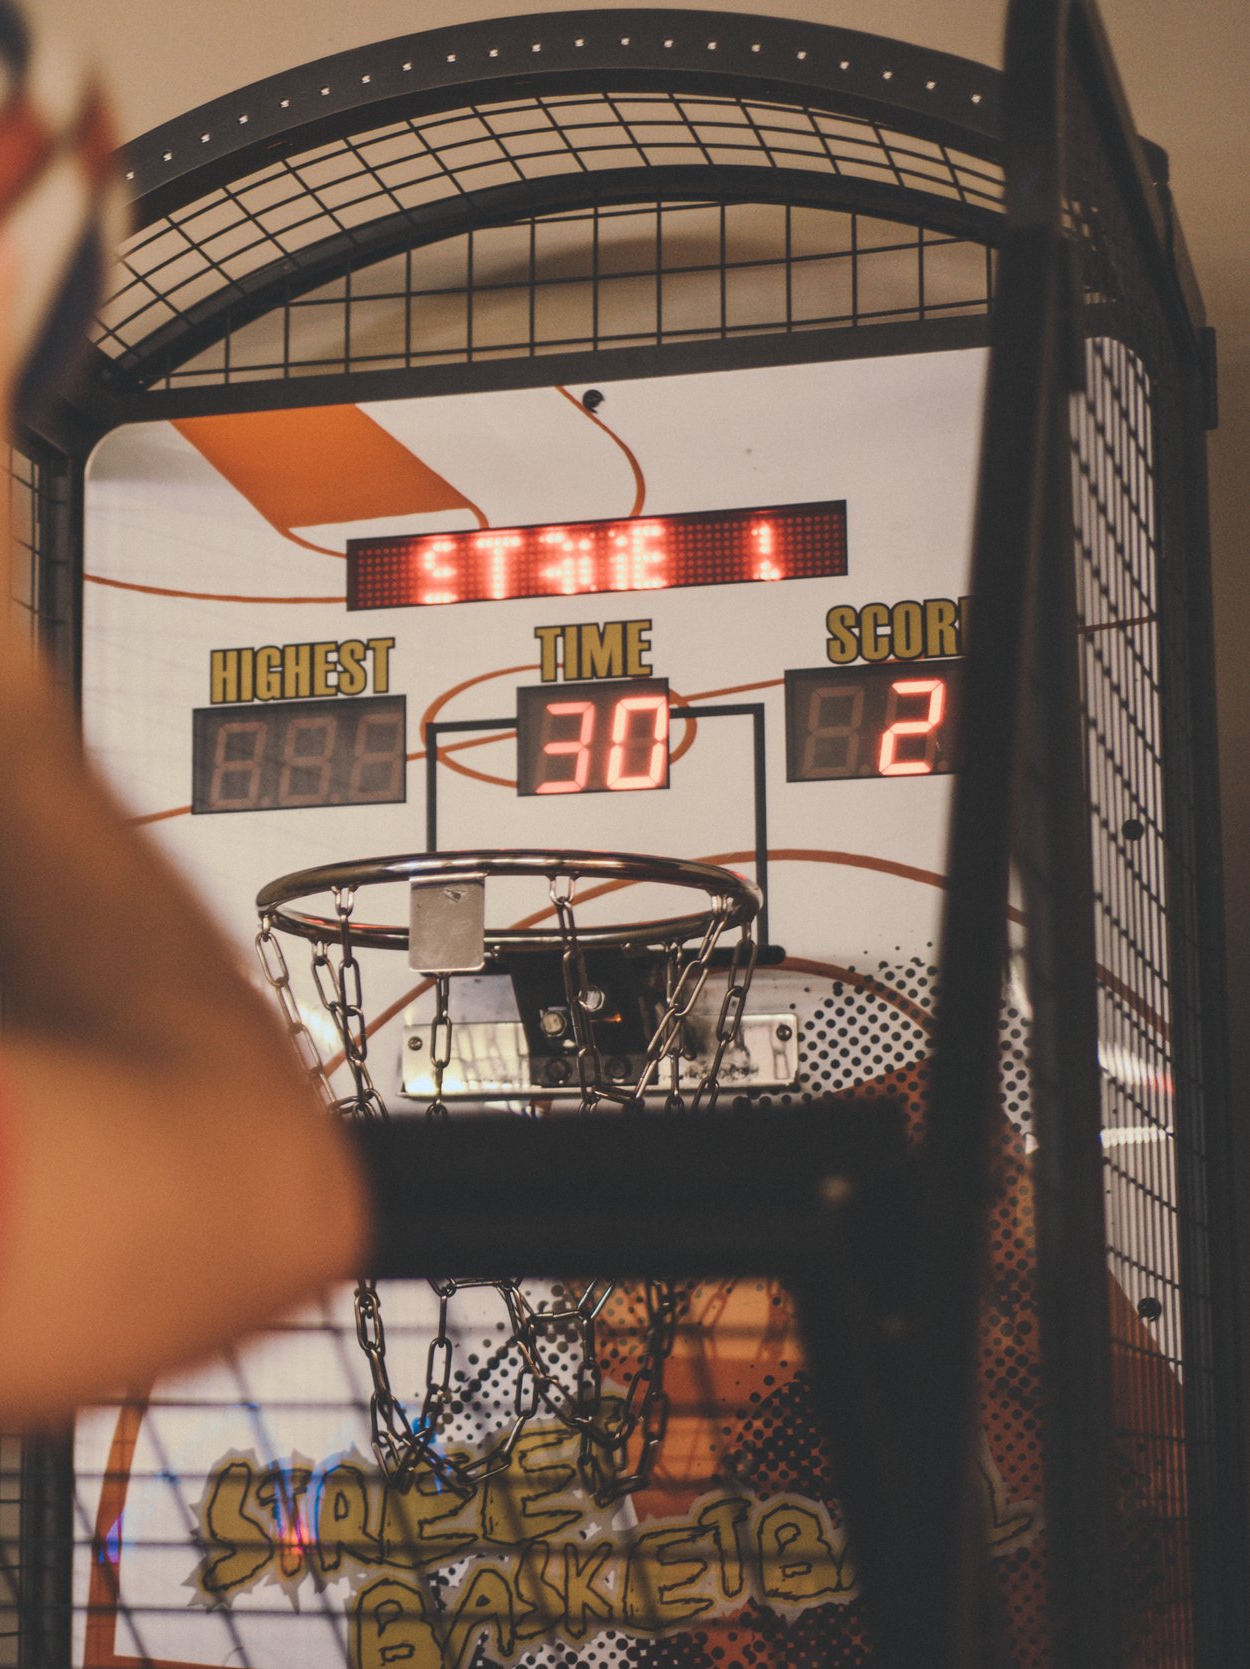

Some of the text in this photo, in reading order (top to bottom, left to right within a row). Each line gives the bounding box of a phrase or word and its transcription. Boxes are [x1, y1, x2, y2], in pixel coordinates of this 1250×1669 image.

[209, 637, 396, 705] HIGHEST
[533, 618, 653, 683] TIME
[825, 596, 972, 665] SCOR
[534, 694, 668, 794] 30
[878, 679, 946, 777] 2
[353, 1440, 1040, 1669] BASKETB
